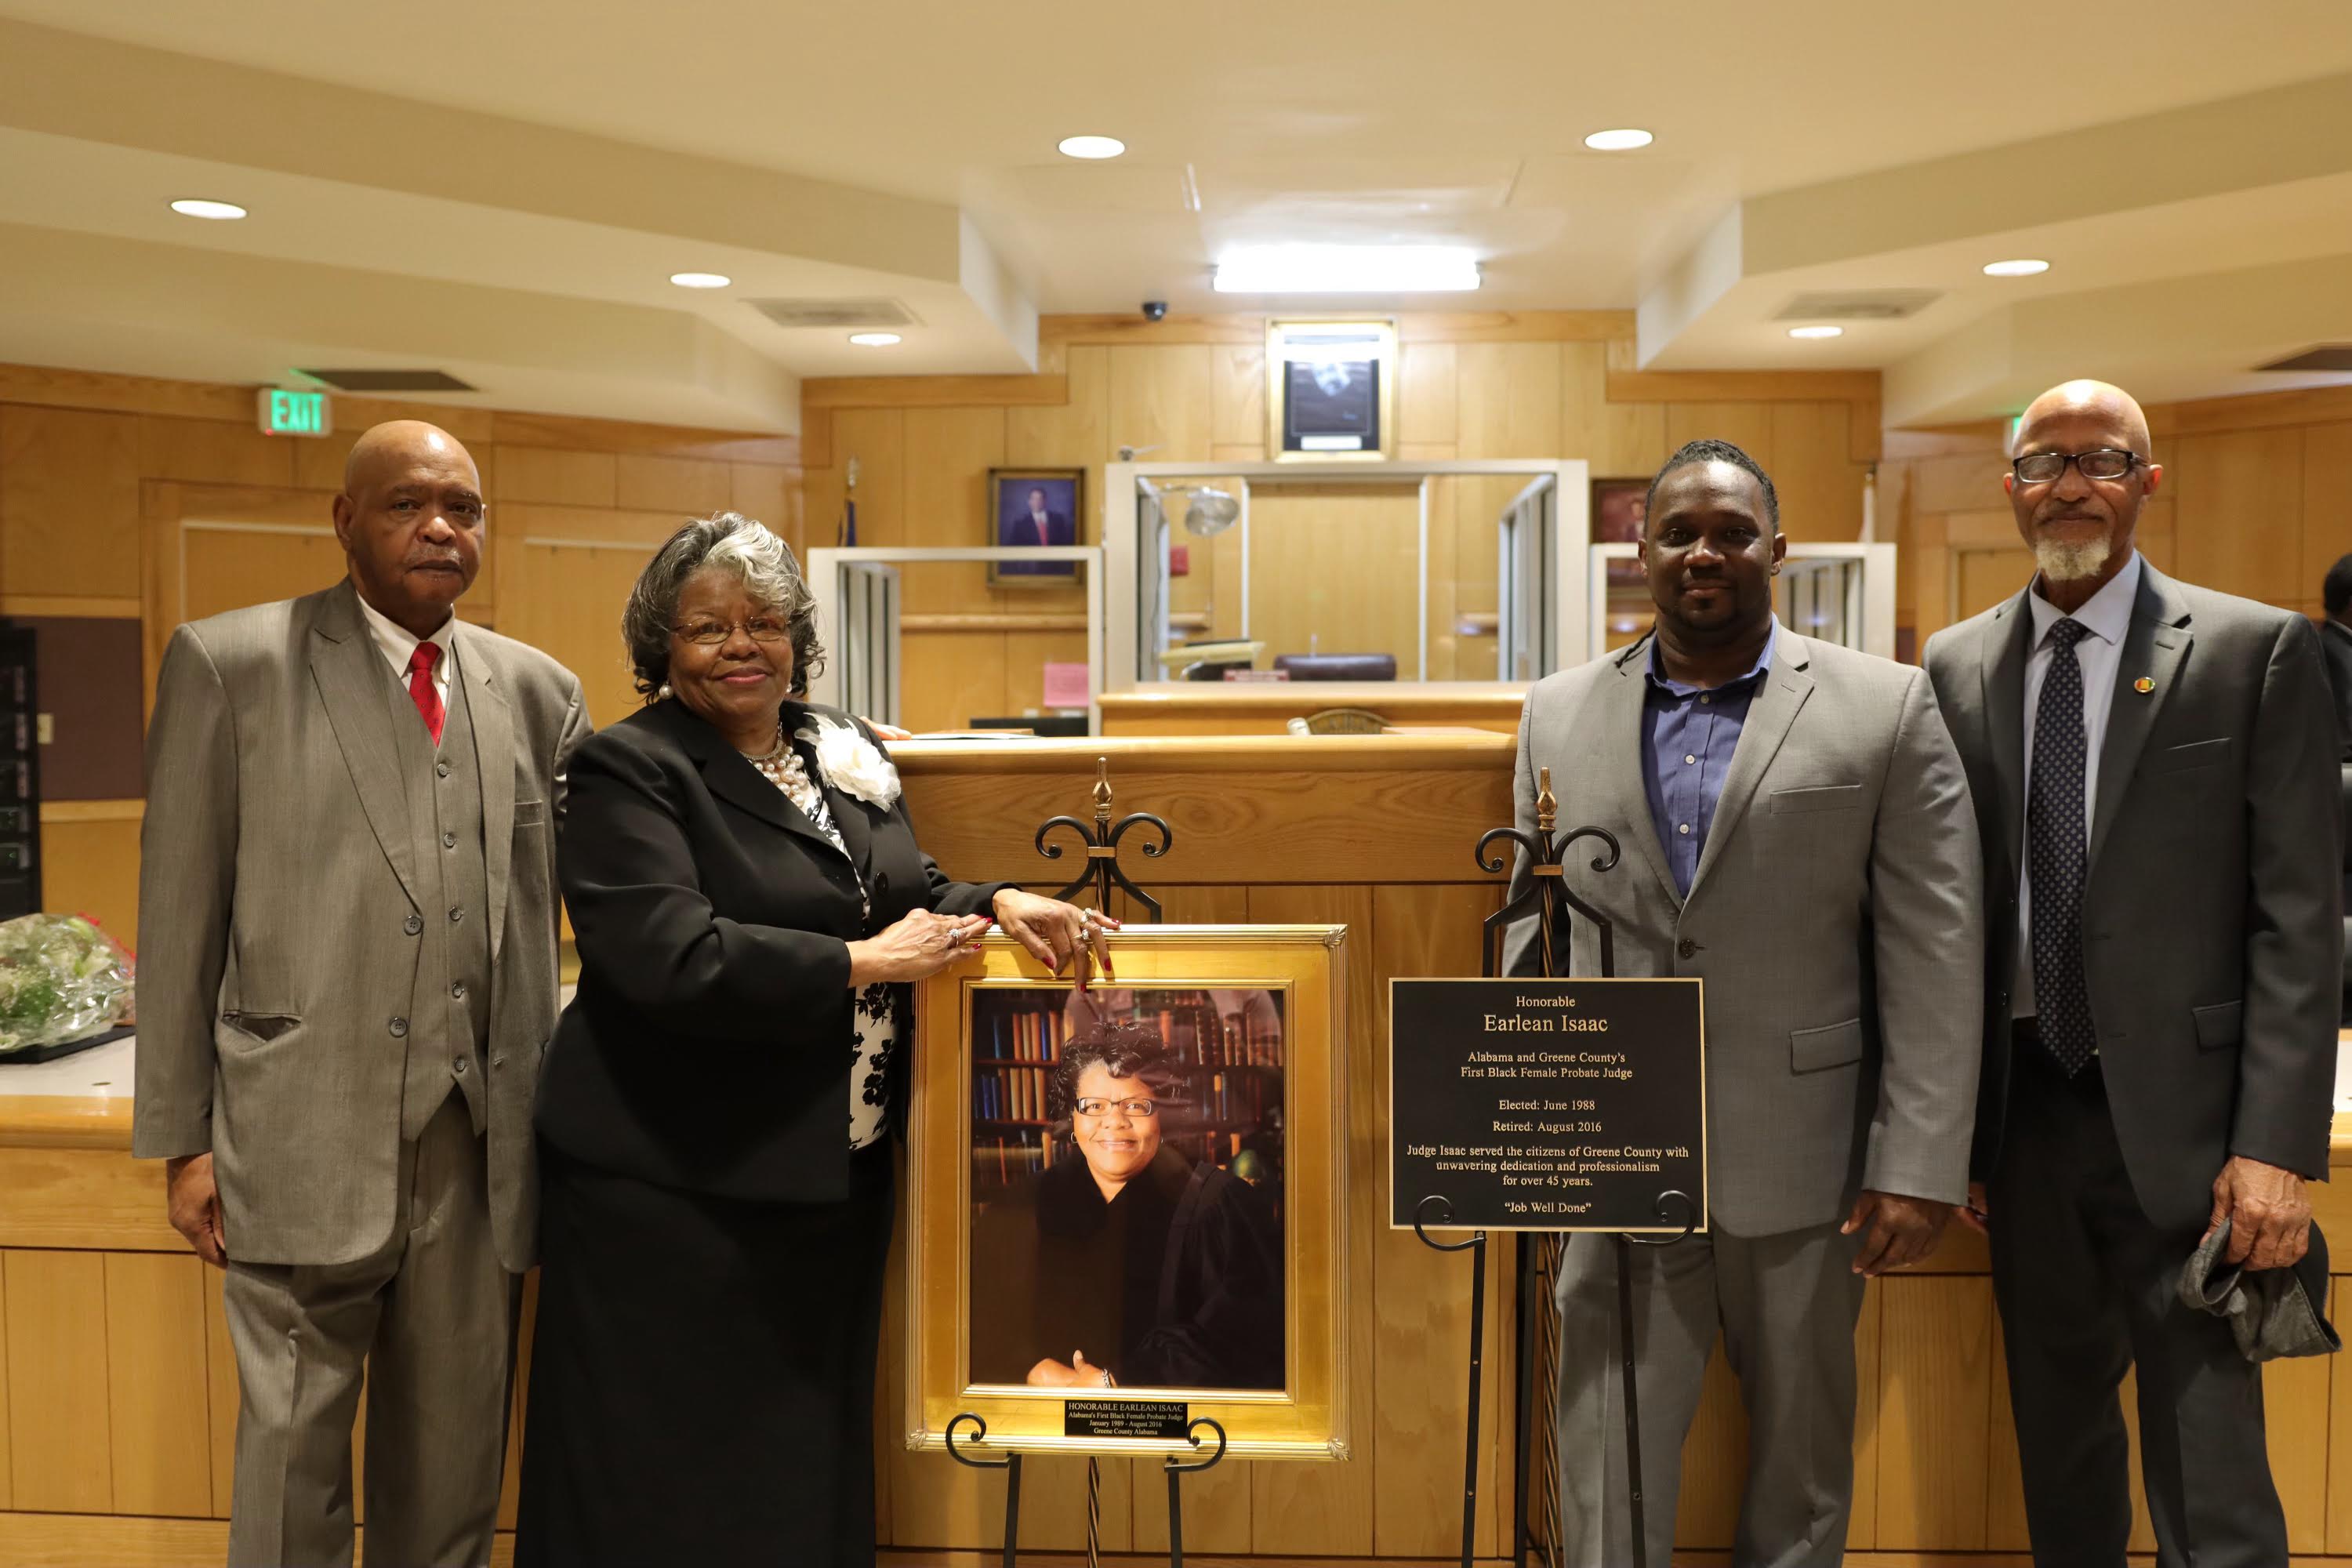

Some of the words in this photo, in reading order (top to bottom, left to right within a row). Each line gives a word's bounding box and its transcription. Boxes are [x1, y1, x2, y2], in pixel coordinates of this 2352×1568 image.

[271, 390, 322, 433] EXIT
[1516, 996, 1575, 1007] Honorable
[1484, 1014, 1553, 1031] Earlean
[1562, 1015, 1608, 1031] Isaac
[1468, 1052, 1513, 1062] Alabama
[1517, 1052, 1535, 1062] and
[1539, 1053, 1576, 1062] Greene
[1461, 1066, 1484, 1076] First
[1488, 1067, 1516, 1077] Black
[1521, 1067, 1557, 1077] Female
[1561, 1068, 1599, 1077] Probate
[1603, 1068, 1632, 1080] Judge
[1499, 1100, 1539, 1109] Elected:
[1544, 1100, 1567, 1109] June
[1573, 1100, 1595, 1110] 1988
[1494, 1121, 1533, 1131] Retired:
[1537, 1122, 1574, 1134] August
[1578, 1122, 1601, 1131] 2016
[1407, 1145, 1436, 1157] Judge
[1440, 1145, 1466, 1156] Isaac
[1470, 1146, 1503, 1156] served
[1507, 1146, 1523, 1156] the
[1526, 1146, 1565, 1156] citizens
[1570, 1146, 1581, 1156] of
[1584, 1146, 1620, 1156] Greene
[1624, 1146, 1662, 1159] County
[1666, 1147, 1688, 1157] with
[1436, 1160, 1497, 1173] unwavering
[1501, 1160, 1553, 1171] dedication
[1557, 1161, 1575, 1171] and
[1579, 1161, 1659, 1174] professionalism
[1503, 1175, 1517, 1185] for
[1547, 1176, 1559, 1185] 45
[1563, 1178, 1592, 1188] years.
[1531, 1203, 1554, 1212] Well
